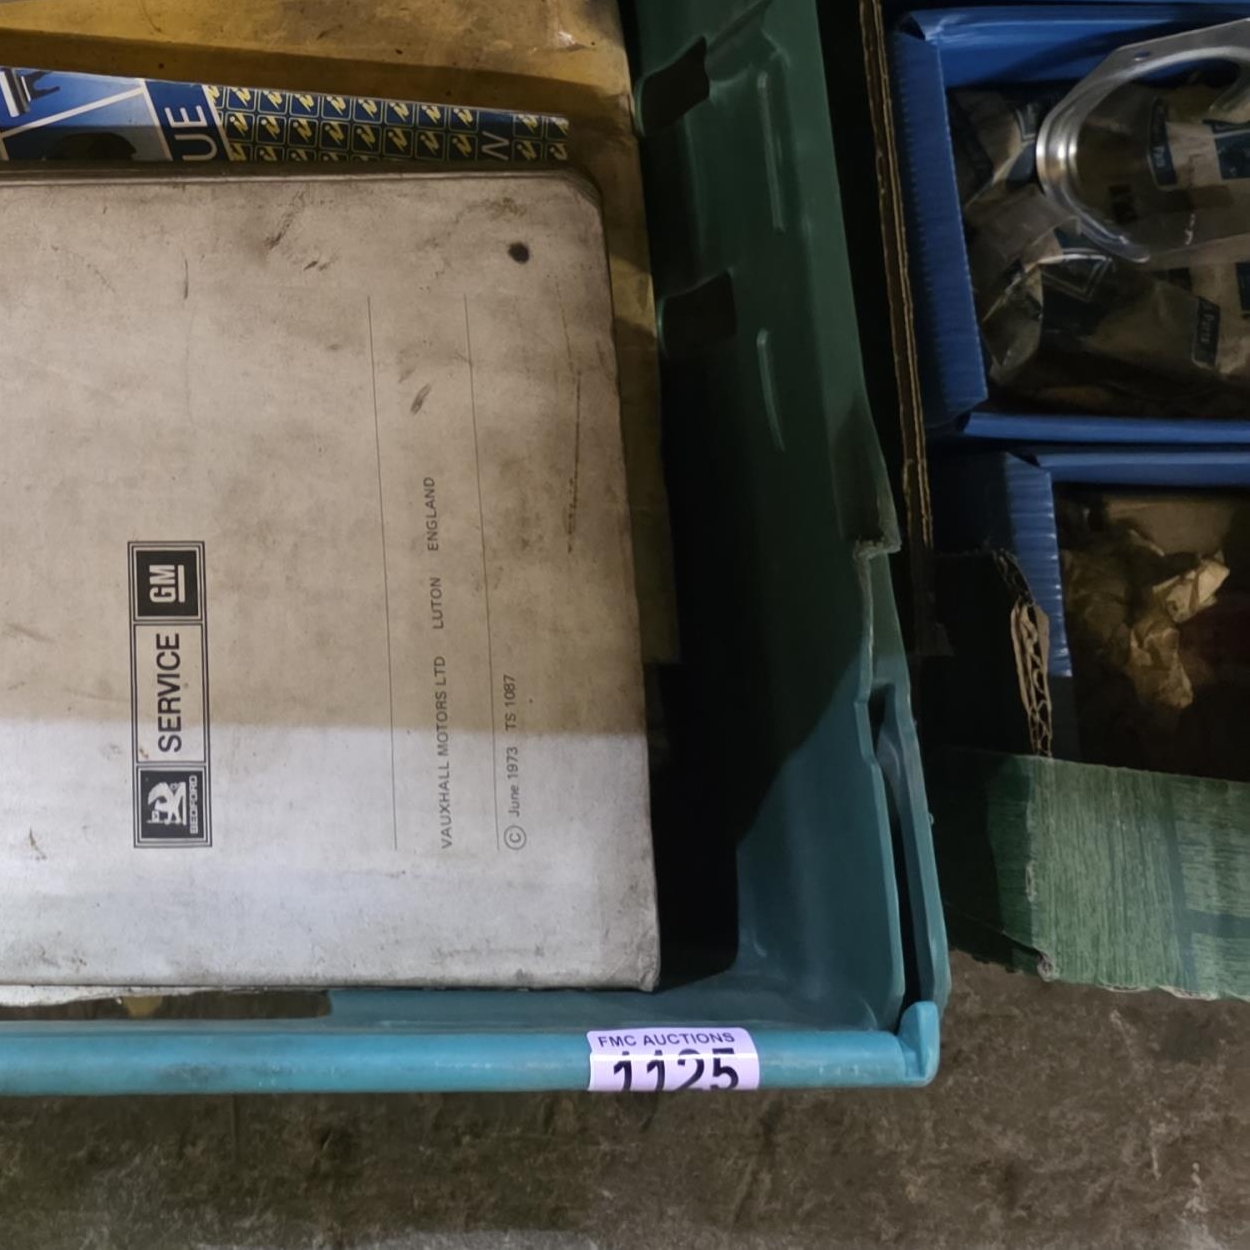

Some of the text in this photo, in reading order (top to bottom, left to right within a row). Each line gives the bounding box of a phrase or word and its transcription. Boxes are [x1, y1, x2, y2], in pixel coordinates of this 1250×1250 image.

[149, 564, 176, 603] GM
[423, 476, 453, 849] VAUXHALL MOTORS LTD LUTON ENGLAND
[156, 633, 182, 753] SERVICE
[504, 674, 516, 709] 1087
[505, 713, 517, 731] TS
[507, 746, 519, 779] 1973
[189, 775, 198, 834] BEDFORD
[509, 784, 521, 817] June
[598, 1032, 735, 1048] FMC AUCTIONS
[613, 1048, 739, 1090] 1125
